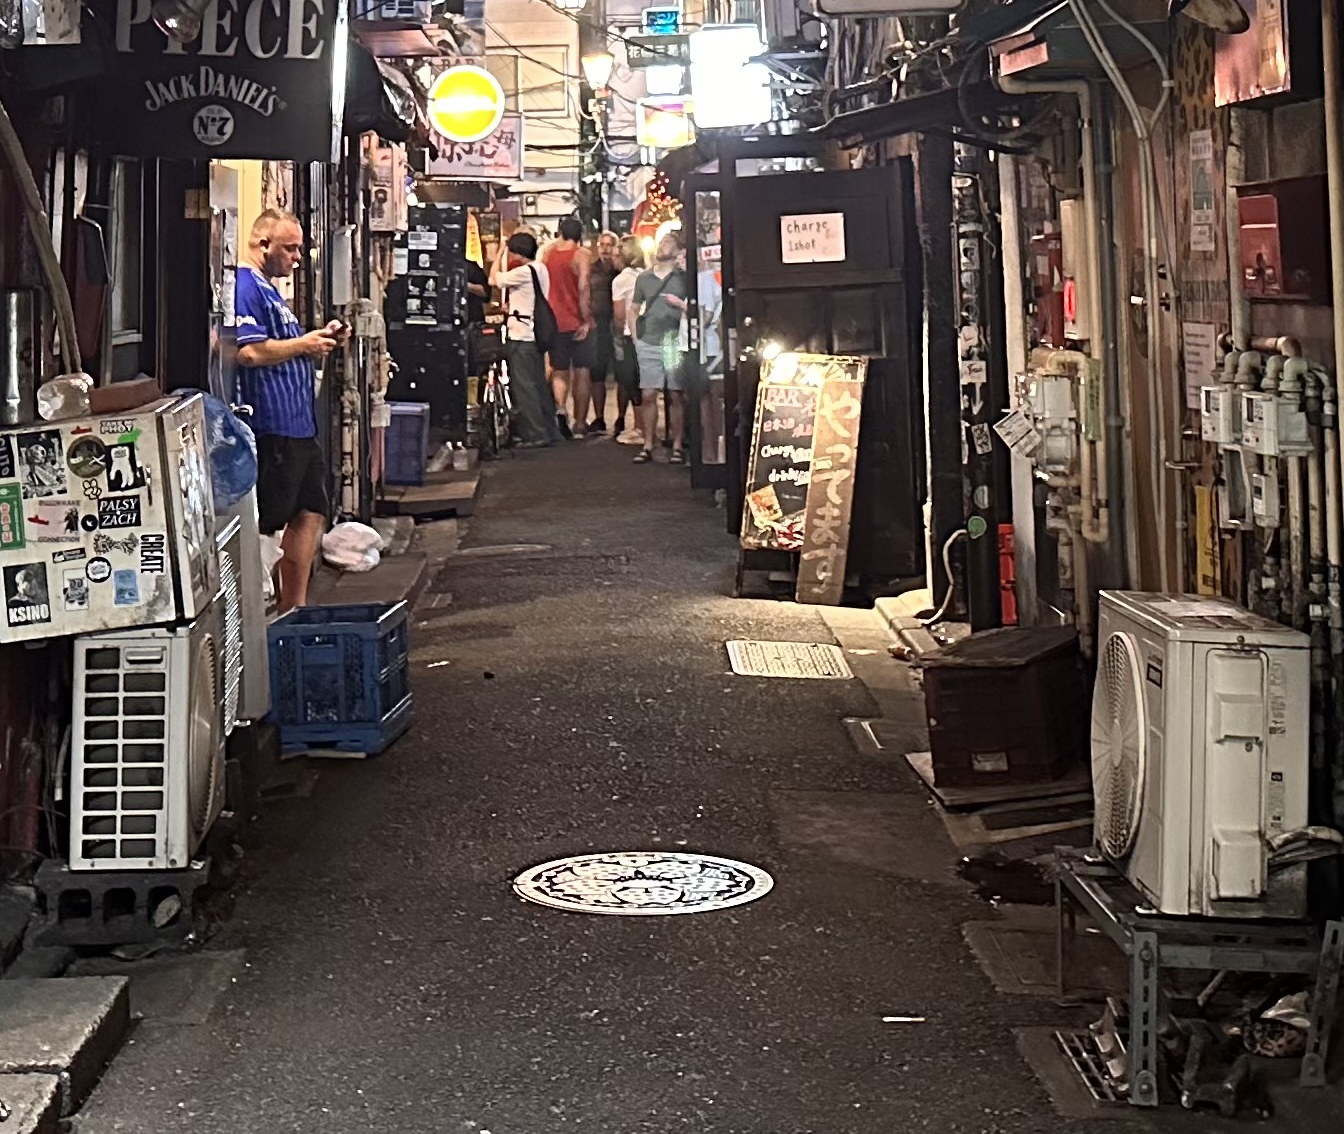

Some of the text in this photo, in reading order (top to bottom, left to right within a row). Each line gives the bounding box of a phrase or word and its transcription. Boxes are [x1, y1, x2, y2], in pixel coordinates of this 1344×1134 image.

[144, 65, 279, 116] JACK DANIEL'S
[786, 219, 828, 234] charge
[99, 498, 139, 512] PALSY
[101, 513, 137, 528] ZACH
[140, 533, 165, 574] CREATE
[8, 603, 50, 624] KSINO
